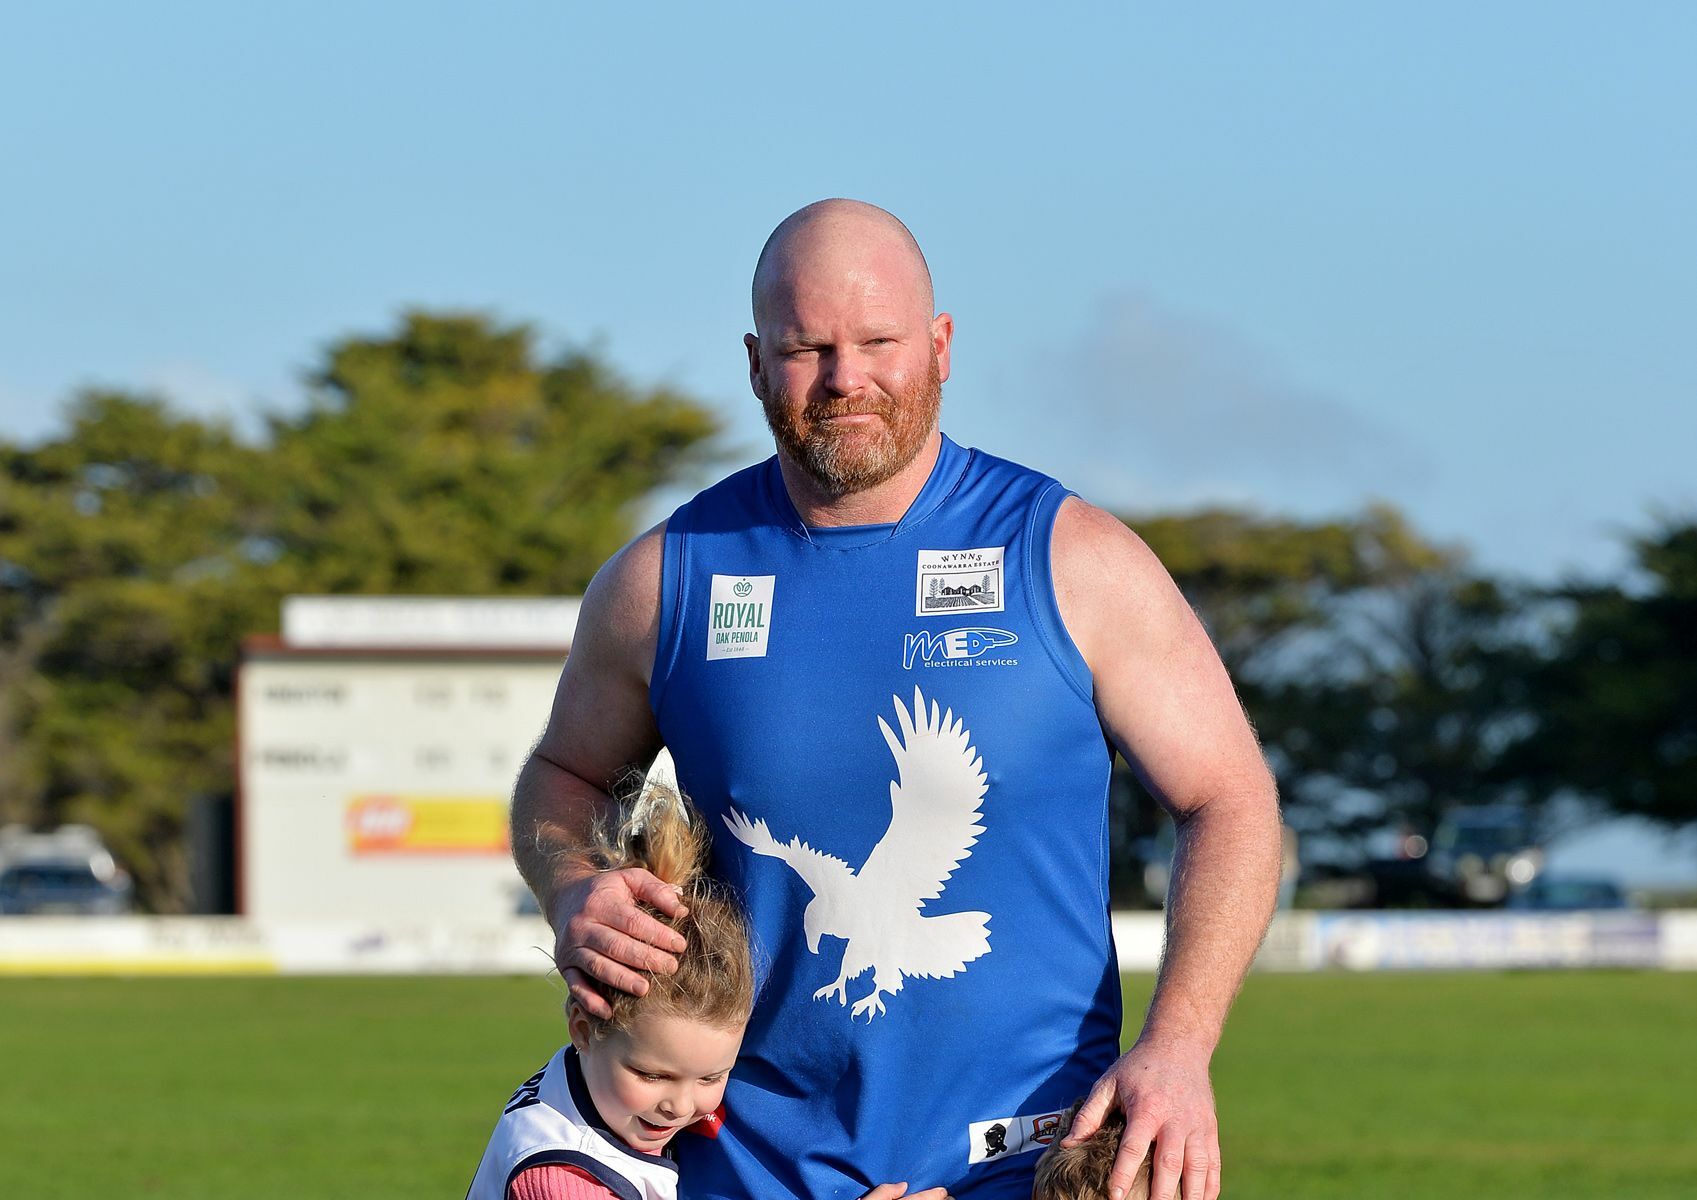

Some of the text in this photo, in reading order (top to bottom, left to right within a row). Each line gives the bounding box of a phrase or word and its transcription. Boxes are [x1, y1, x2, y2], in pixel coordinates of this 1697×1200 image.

[941, 553, 982, 562] WYNNS
[713, 603, 765, 629] ROYAL
[716, 632, 758, 644] OAK PENOLA
[924, 659, 1018, 668] electrical services
